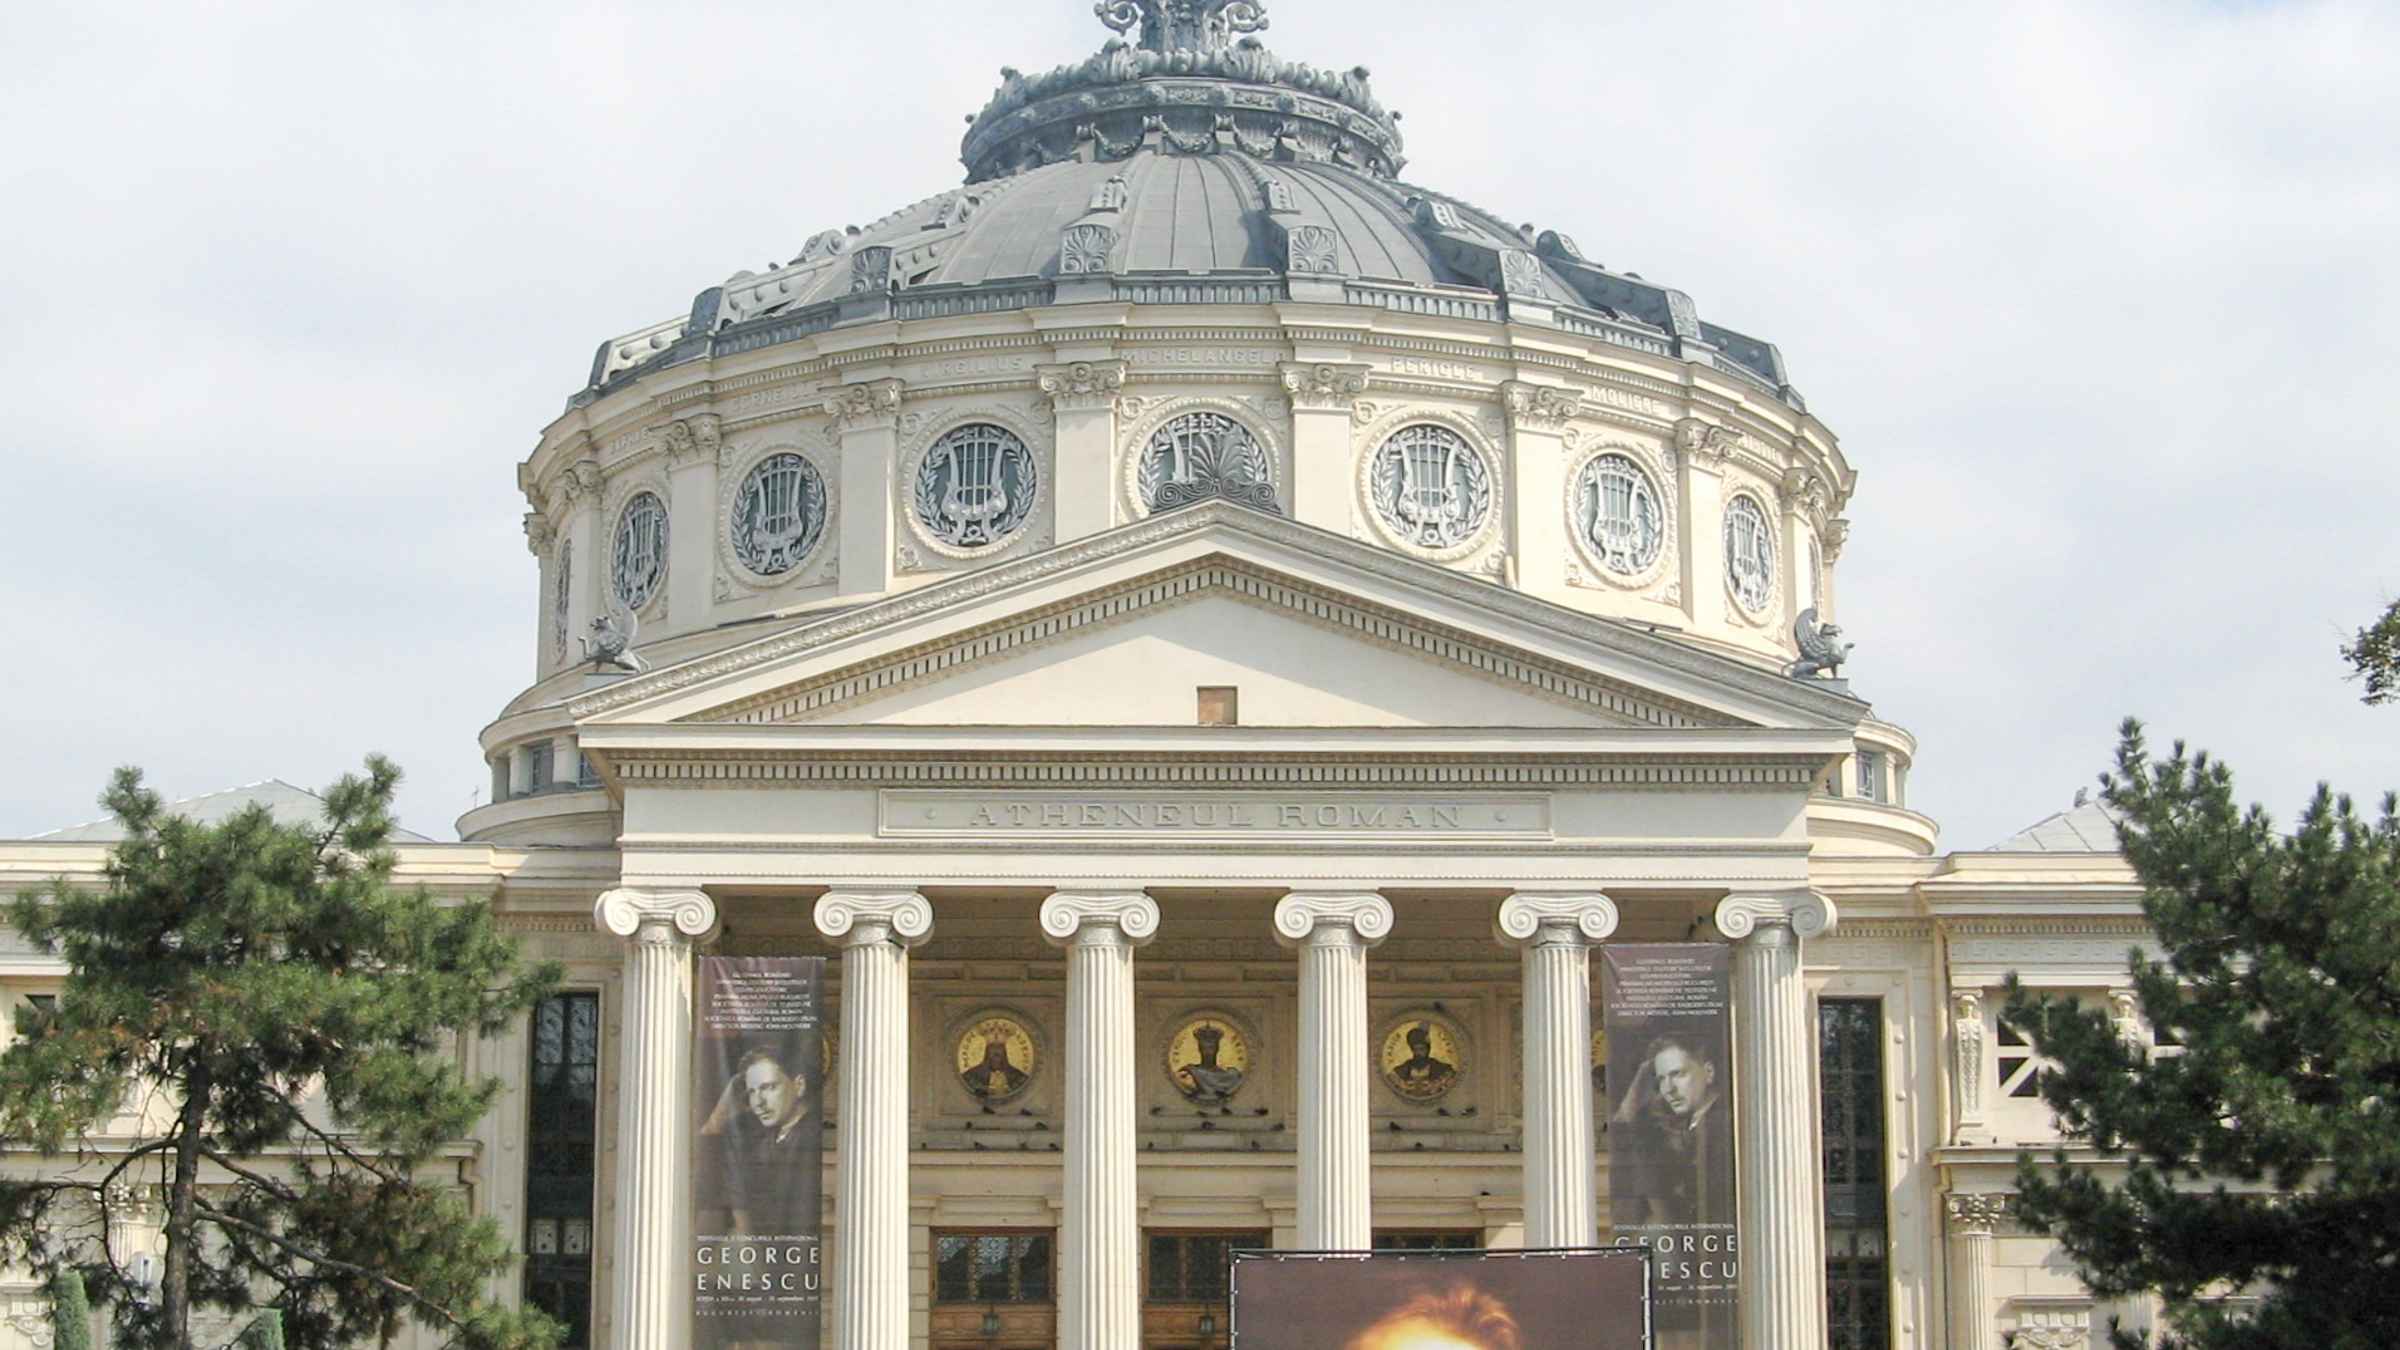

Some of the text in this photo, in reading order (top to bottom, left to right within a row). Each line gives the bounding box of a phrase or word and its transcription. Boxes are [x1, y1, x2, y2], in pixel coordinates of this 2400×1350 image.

[970, 802, 1460, 828] ATHENEUL ROMAN
[697, 1246, 820, 1265] GEORGE
[1661, 1261, 1737, 1280] ESCU
[697, 1272, 820, 1291] ENESCU
